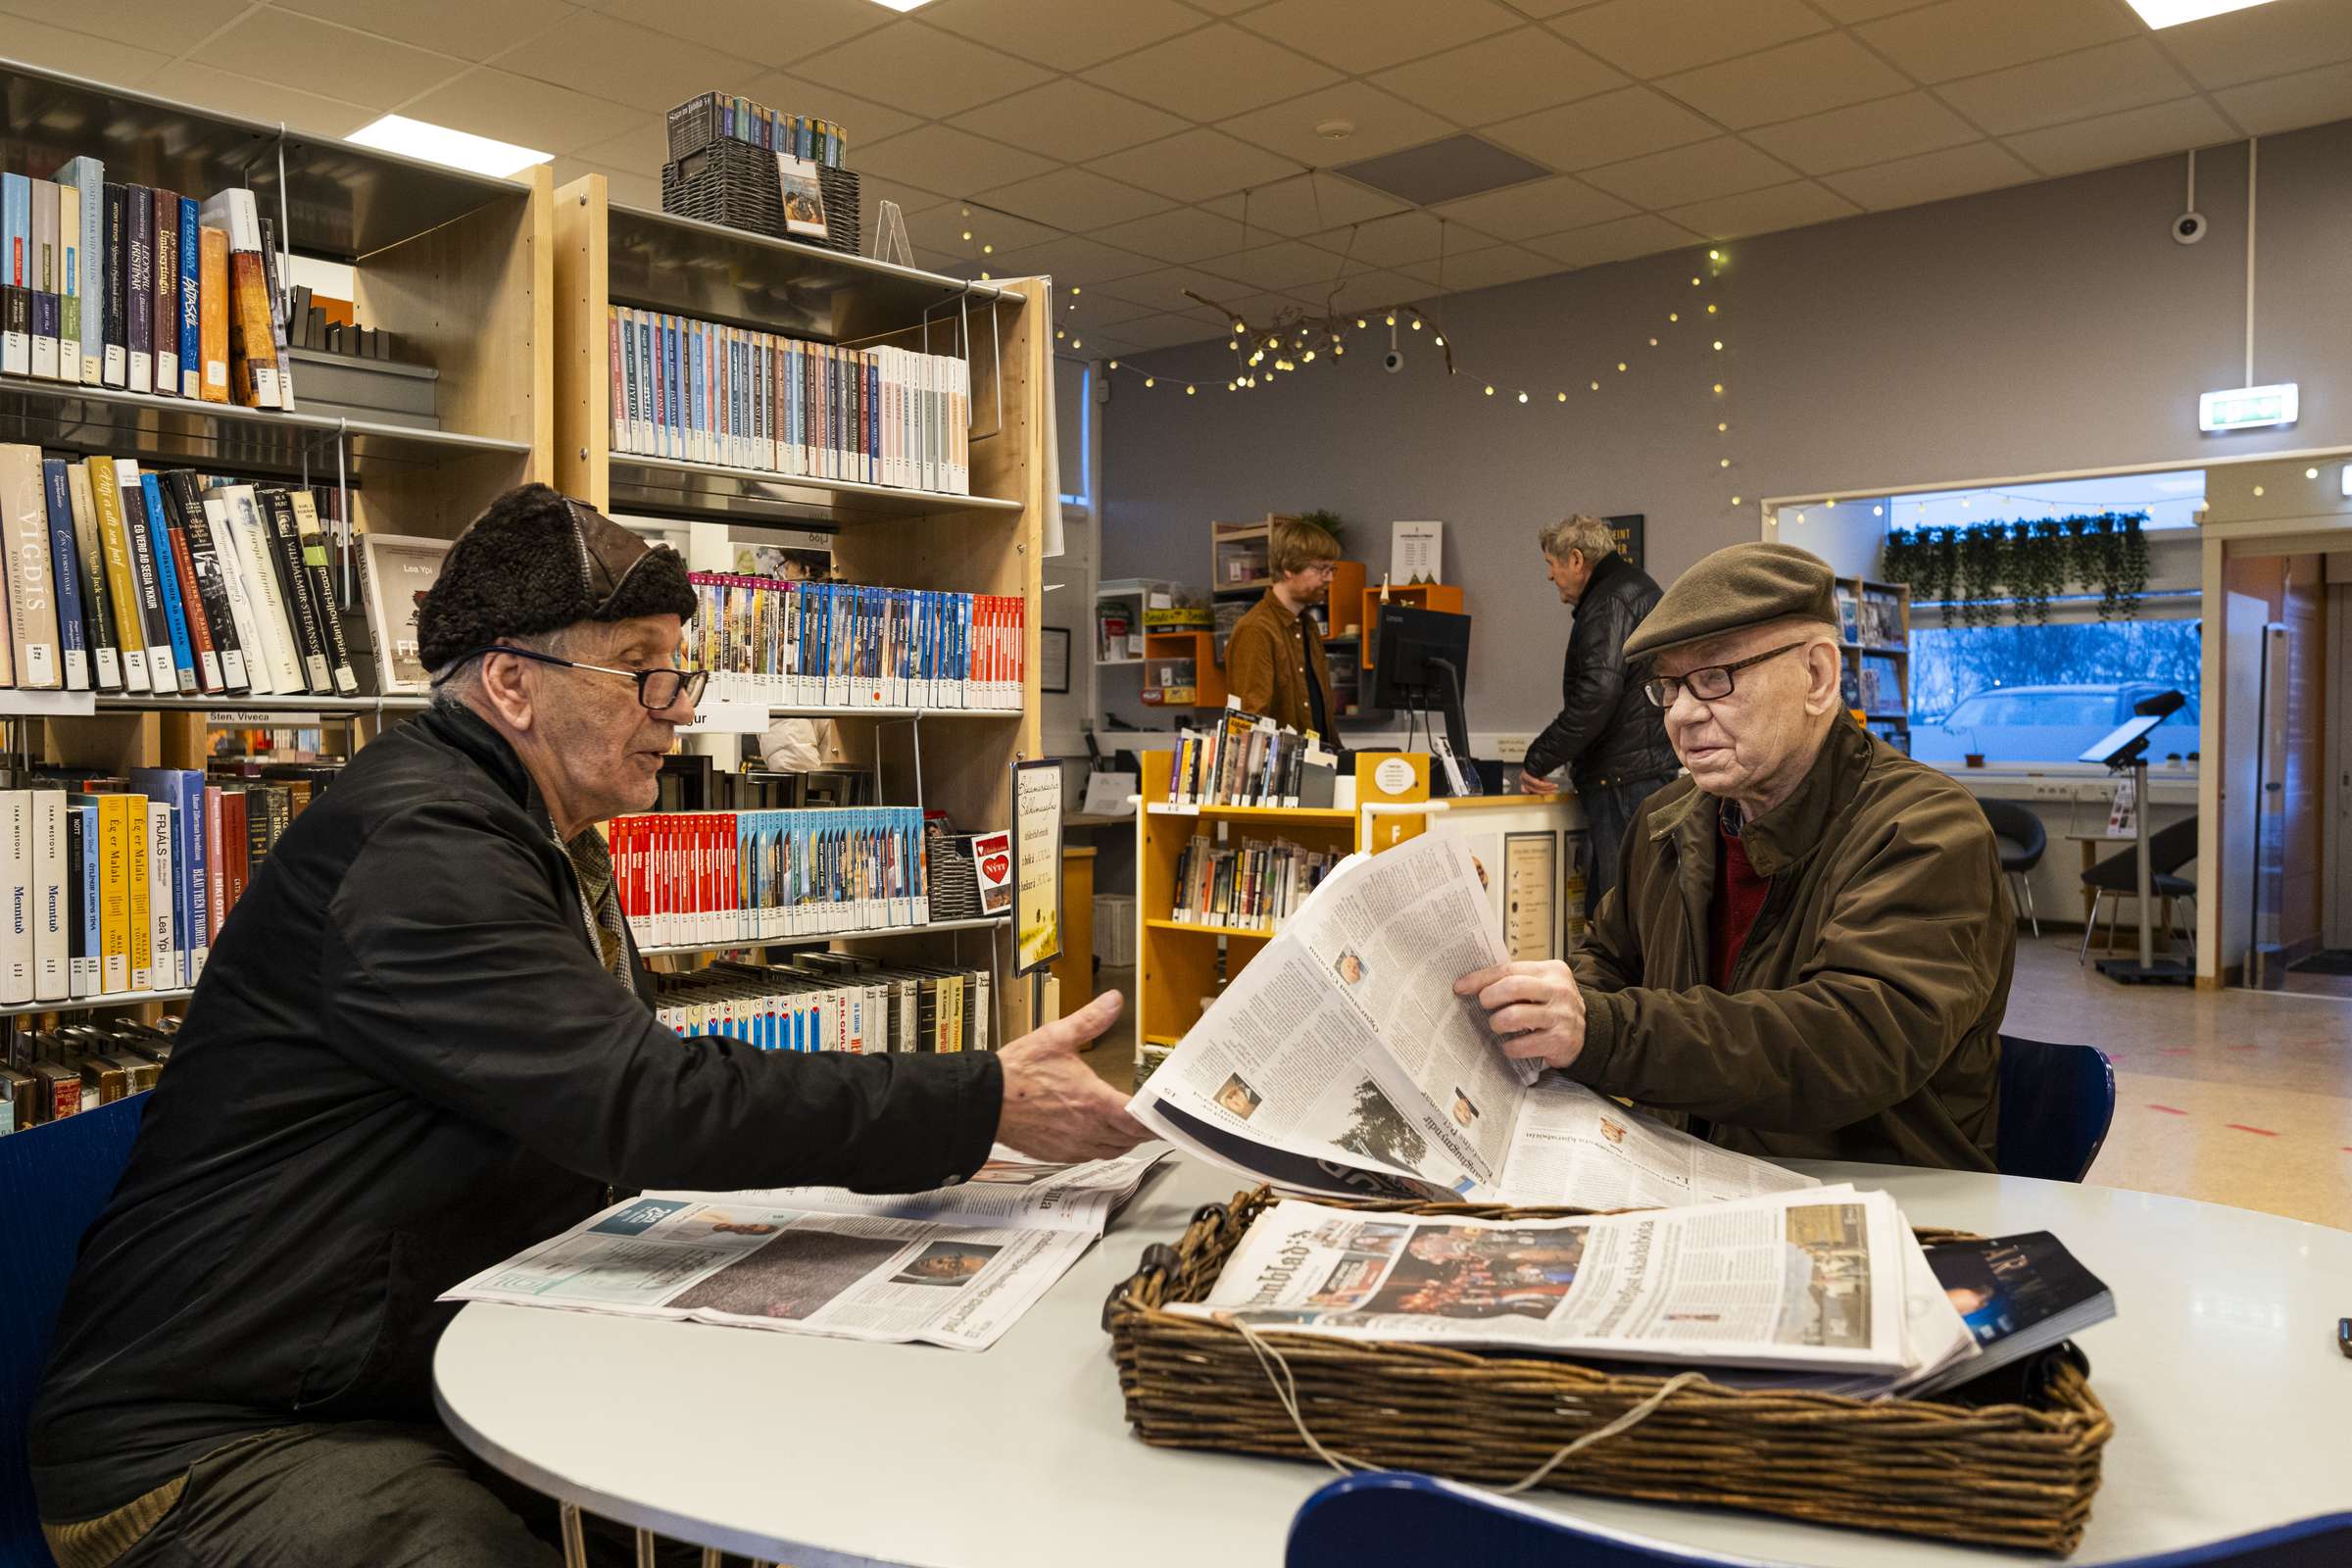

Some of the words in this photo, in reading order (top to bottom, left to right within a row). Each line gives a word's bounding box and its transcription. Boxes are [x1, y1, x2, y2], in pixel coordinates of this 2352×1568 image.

[104, 509, 117, 527] allt
[108, 529, 118, 545] sem
[19, 508, 49, 612] VIGDÍS
[403, 564, 419, 573] Lea
[419, 565, 433, 574] Ypi
[140, 564, 154, 585] SEGJA
[91, 575, 103, 594] Jack
[10, 550, 20, 574] KONA
[15, 607, 25, 641] FORSETI
[144, 586, 158, 610] YKKUR
[210, 712, 235, 722] Sten,
[237, 712, 270, 721] Viveca
[108, 819, 122, 832] Ég
[132, 818, 146, 832] Ég
[1392, 824, 1401, 843] F
[111, 836, 118, 847] er
[134, 835, 142, 846] er
[156, 814, 170, 857] FRJÁLS
[110, 850, 121, 884] Malala
[134, 849, 146, 882] Malala
[986, 861, 1005, 873] NÝTT
[215, 878, 224, 898] RÍKI
[13, 886, 25, 935] Menntuð
[47, 885, 60, 933] Menntuð
[159, 915, 169, 934] Lea
[156, 937, 169, 953] Ypi
